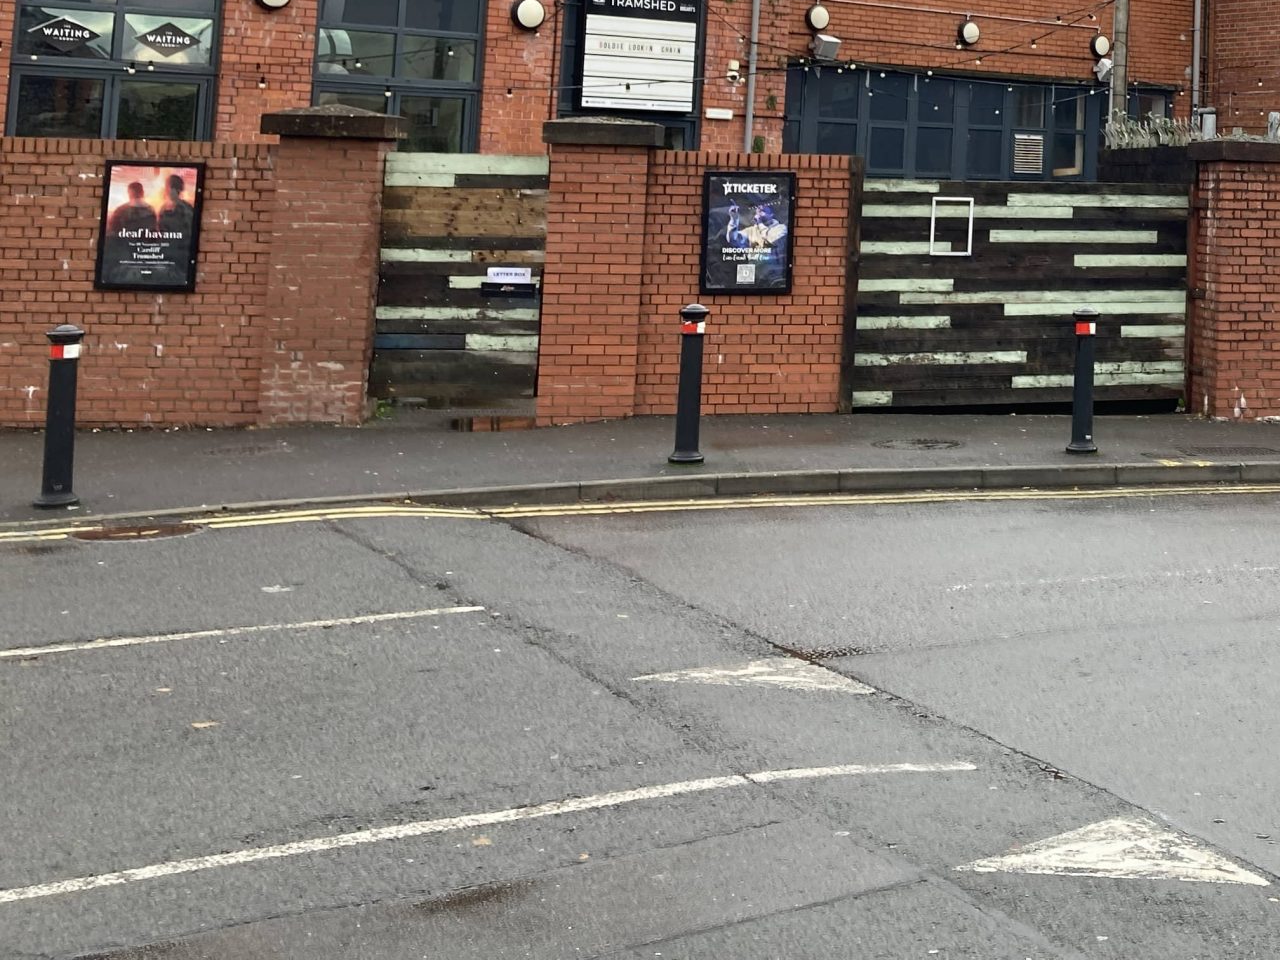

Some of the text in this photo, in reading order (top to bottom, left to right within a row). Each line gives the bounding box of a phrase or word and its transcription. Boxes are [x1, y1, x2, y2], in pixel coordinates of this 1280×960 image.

[43, 27, 90, 38] WAITING
[146, 34, 190, 44] WAITING
[732, 183, 777, 194] TICKETEK
[119, 228, 182, 239] deaf havana
